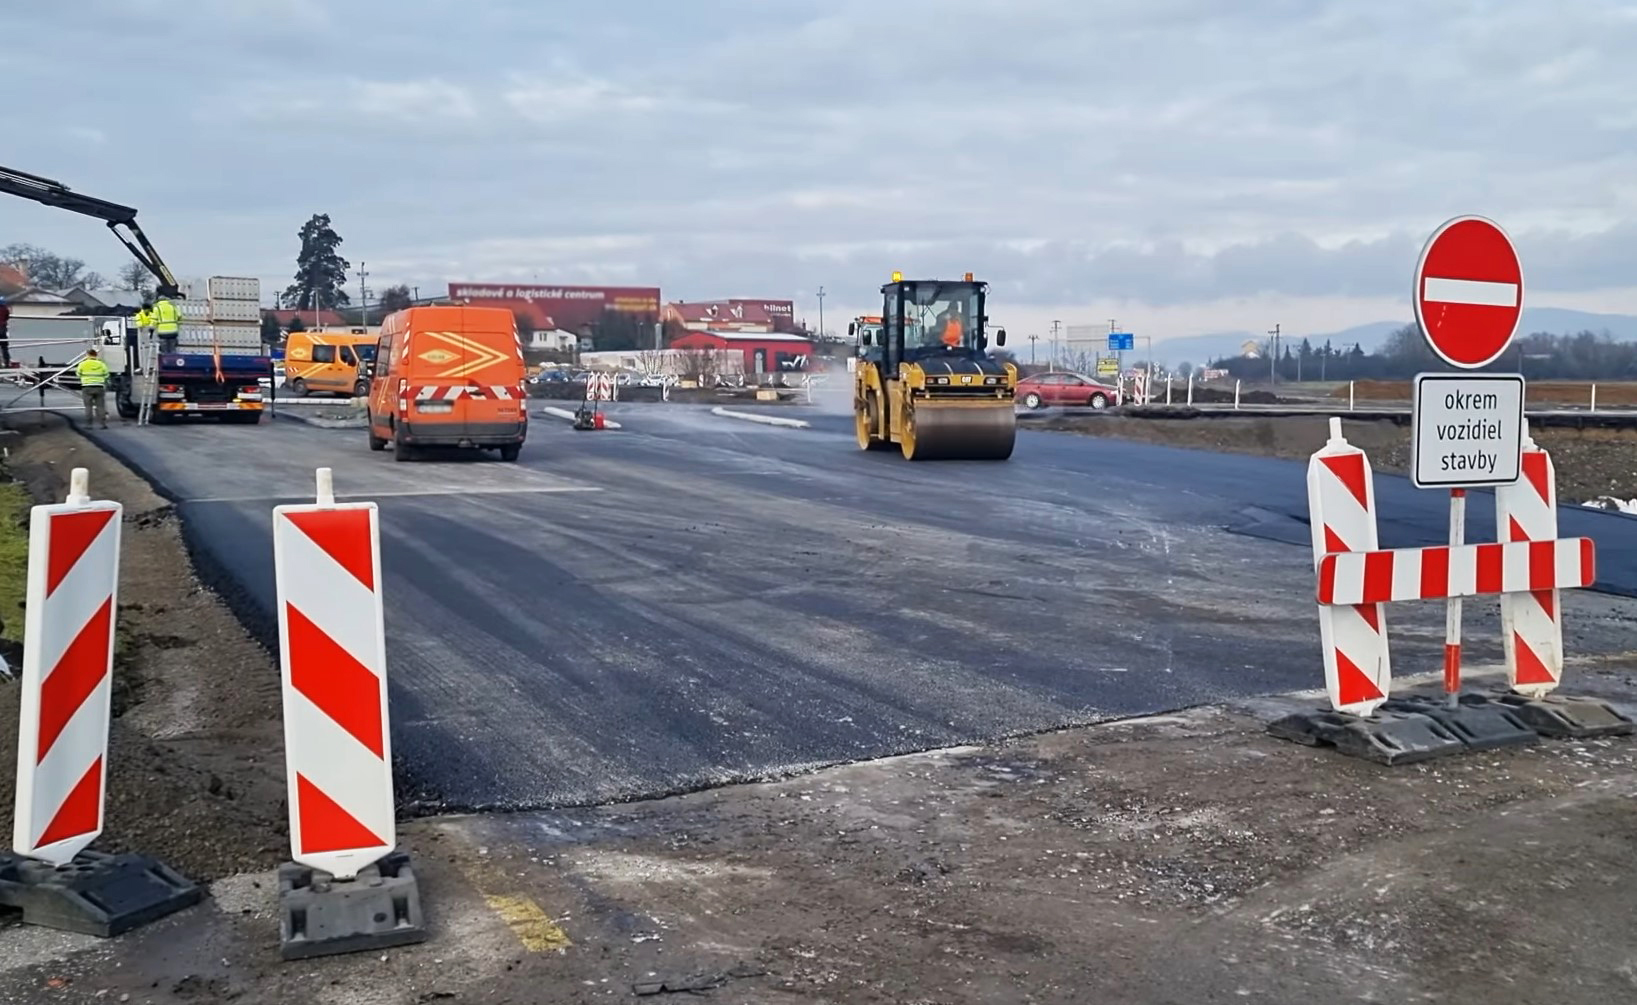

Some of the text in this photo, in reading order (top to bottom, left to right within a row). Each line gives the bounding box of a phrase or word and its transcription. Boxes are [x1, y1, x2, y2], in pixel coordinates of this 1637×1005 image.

[564, 290, 605, 300] centrum
[1444, 389, 1498, 410] okrem
[1436, 418, 1502, 441] vozidiel
[1441, 449, 1498, 474] stavby
